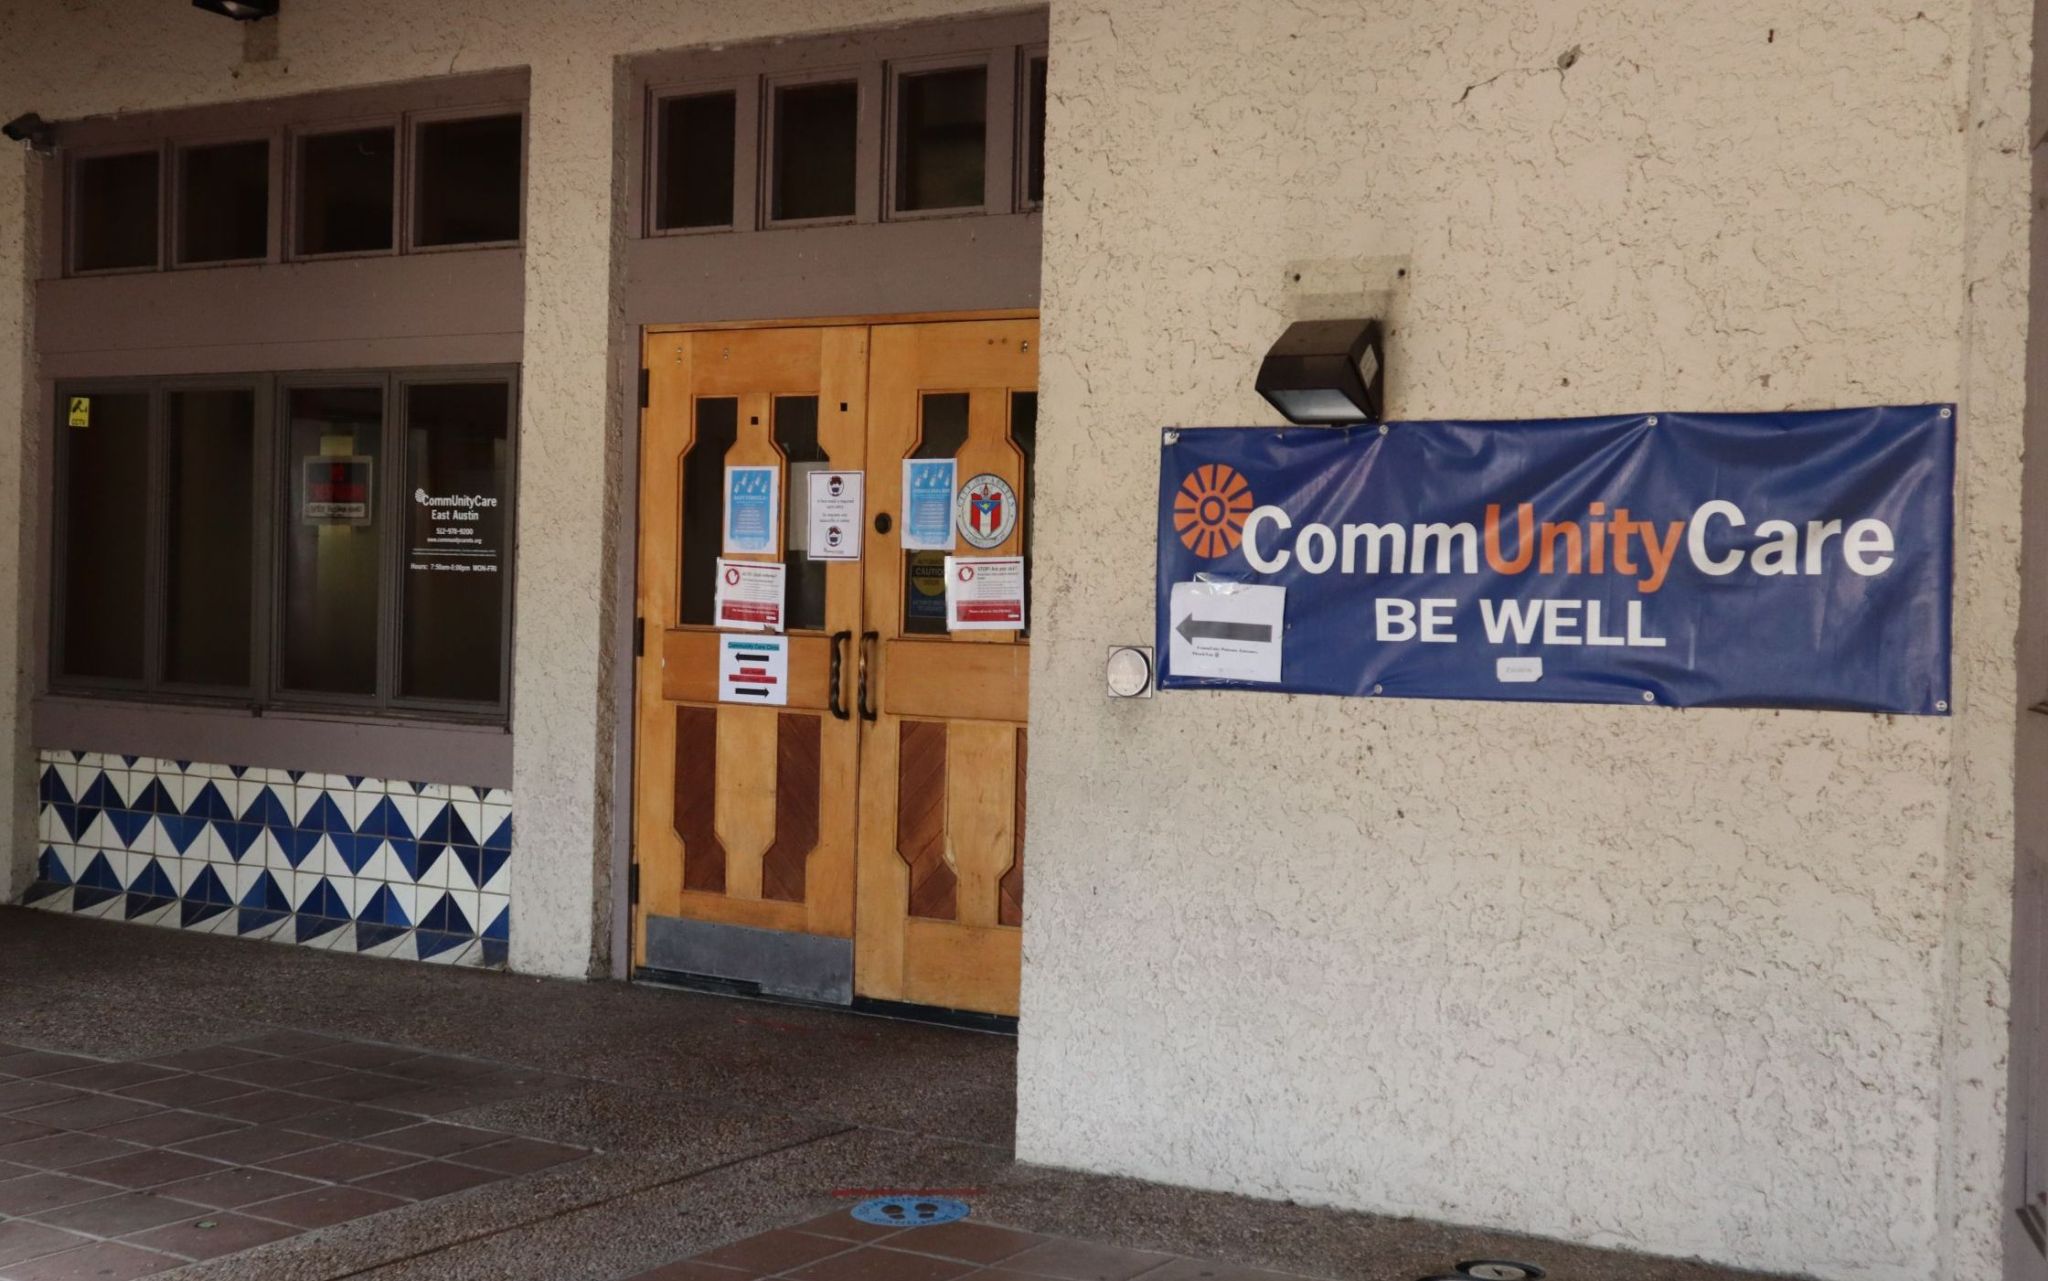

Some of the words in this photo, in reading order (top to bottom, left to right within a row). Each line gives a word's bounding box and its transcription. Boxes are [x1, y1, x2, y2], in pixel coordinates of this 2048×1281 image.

[423, 494, 497, 509] CommUnityCare
[431, 509, 450, 520] East
[452, 509, 479, 520] Austin
[1241, 499, 1896, 594] CommUnityCare
[914, 566, 945, 577] CAUTIO
[1374, 598, 1457, 643] BE
[1479, 598, 1667, 647] WELL
